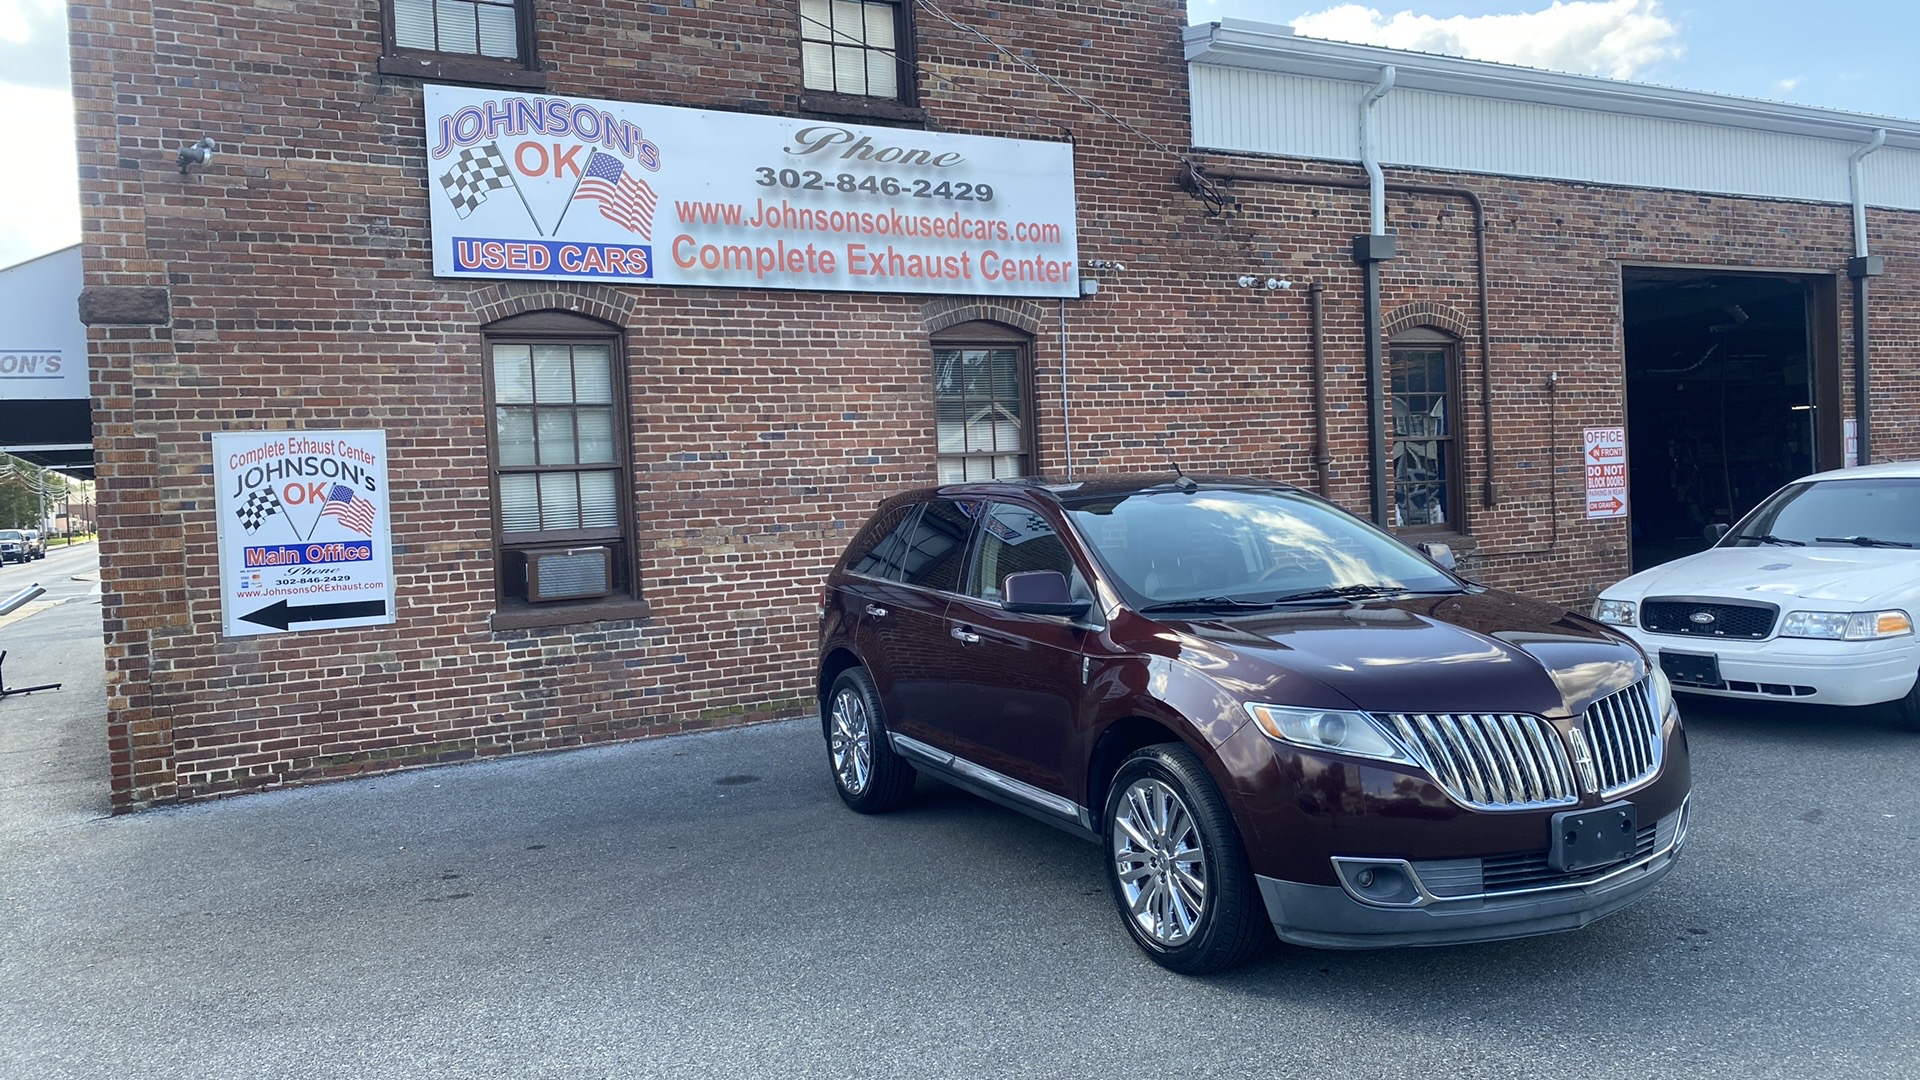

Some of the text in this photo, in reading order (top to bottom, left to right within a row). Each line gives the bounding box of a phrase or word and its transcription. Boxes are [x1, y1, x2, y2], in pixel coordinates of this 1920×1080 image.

[432, 97, 660, 172] JOHNSON's
[783, 126, 965, 168] Phone
[514, 141, 583, 178] OK
[755, 166, 994, 202] 302-846-2429
[674, 198, 1060, 244] www.Johnsonsokusedcars.com
[458, 240, 648, 275] USED CARS
[672, 234, 1072, 283] Complete Exhaust Center
[1586, 431, 1623, 443] OFFICE
[230, 437, 376, 470] Complete Exhaust Center
[1593, 448, 1622, 457] IN FRONT
[233, 456, 376, 498] JOHNSON's
[1588, 465, 1624, 477] DO NOT
[1588, 475, 1624, 488] BLOCK DOORS
[283, 482, 328, 505] OK
[1598, 501, 1618, 509] GRAVEL
[246, 543, 370, 566] Main Office
[275, 574, 351, 586] 302-846-2429
[284, 567, 340, 576] Phone
[237, 581, 384, 598] www.JohnsonsOKExhaust.com
